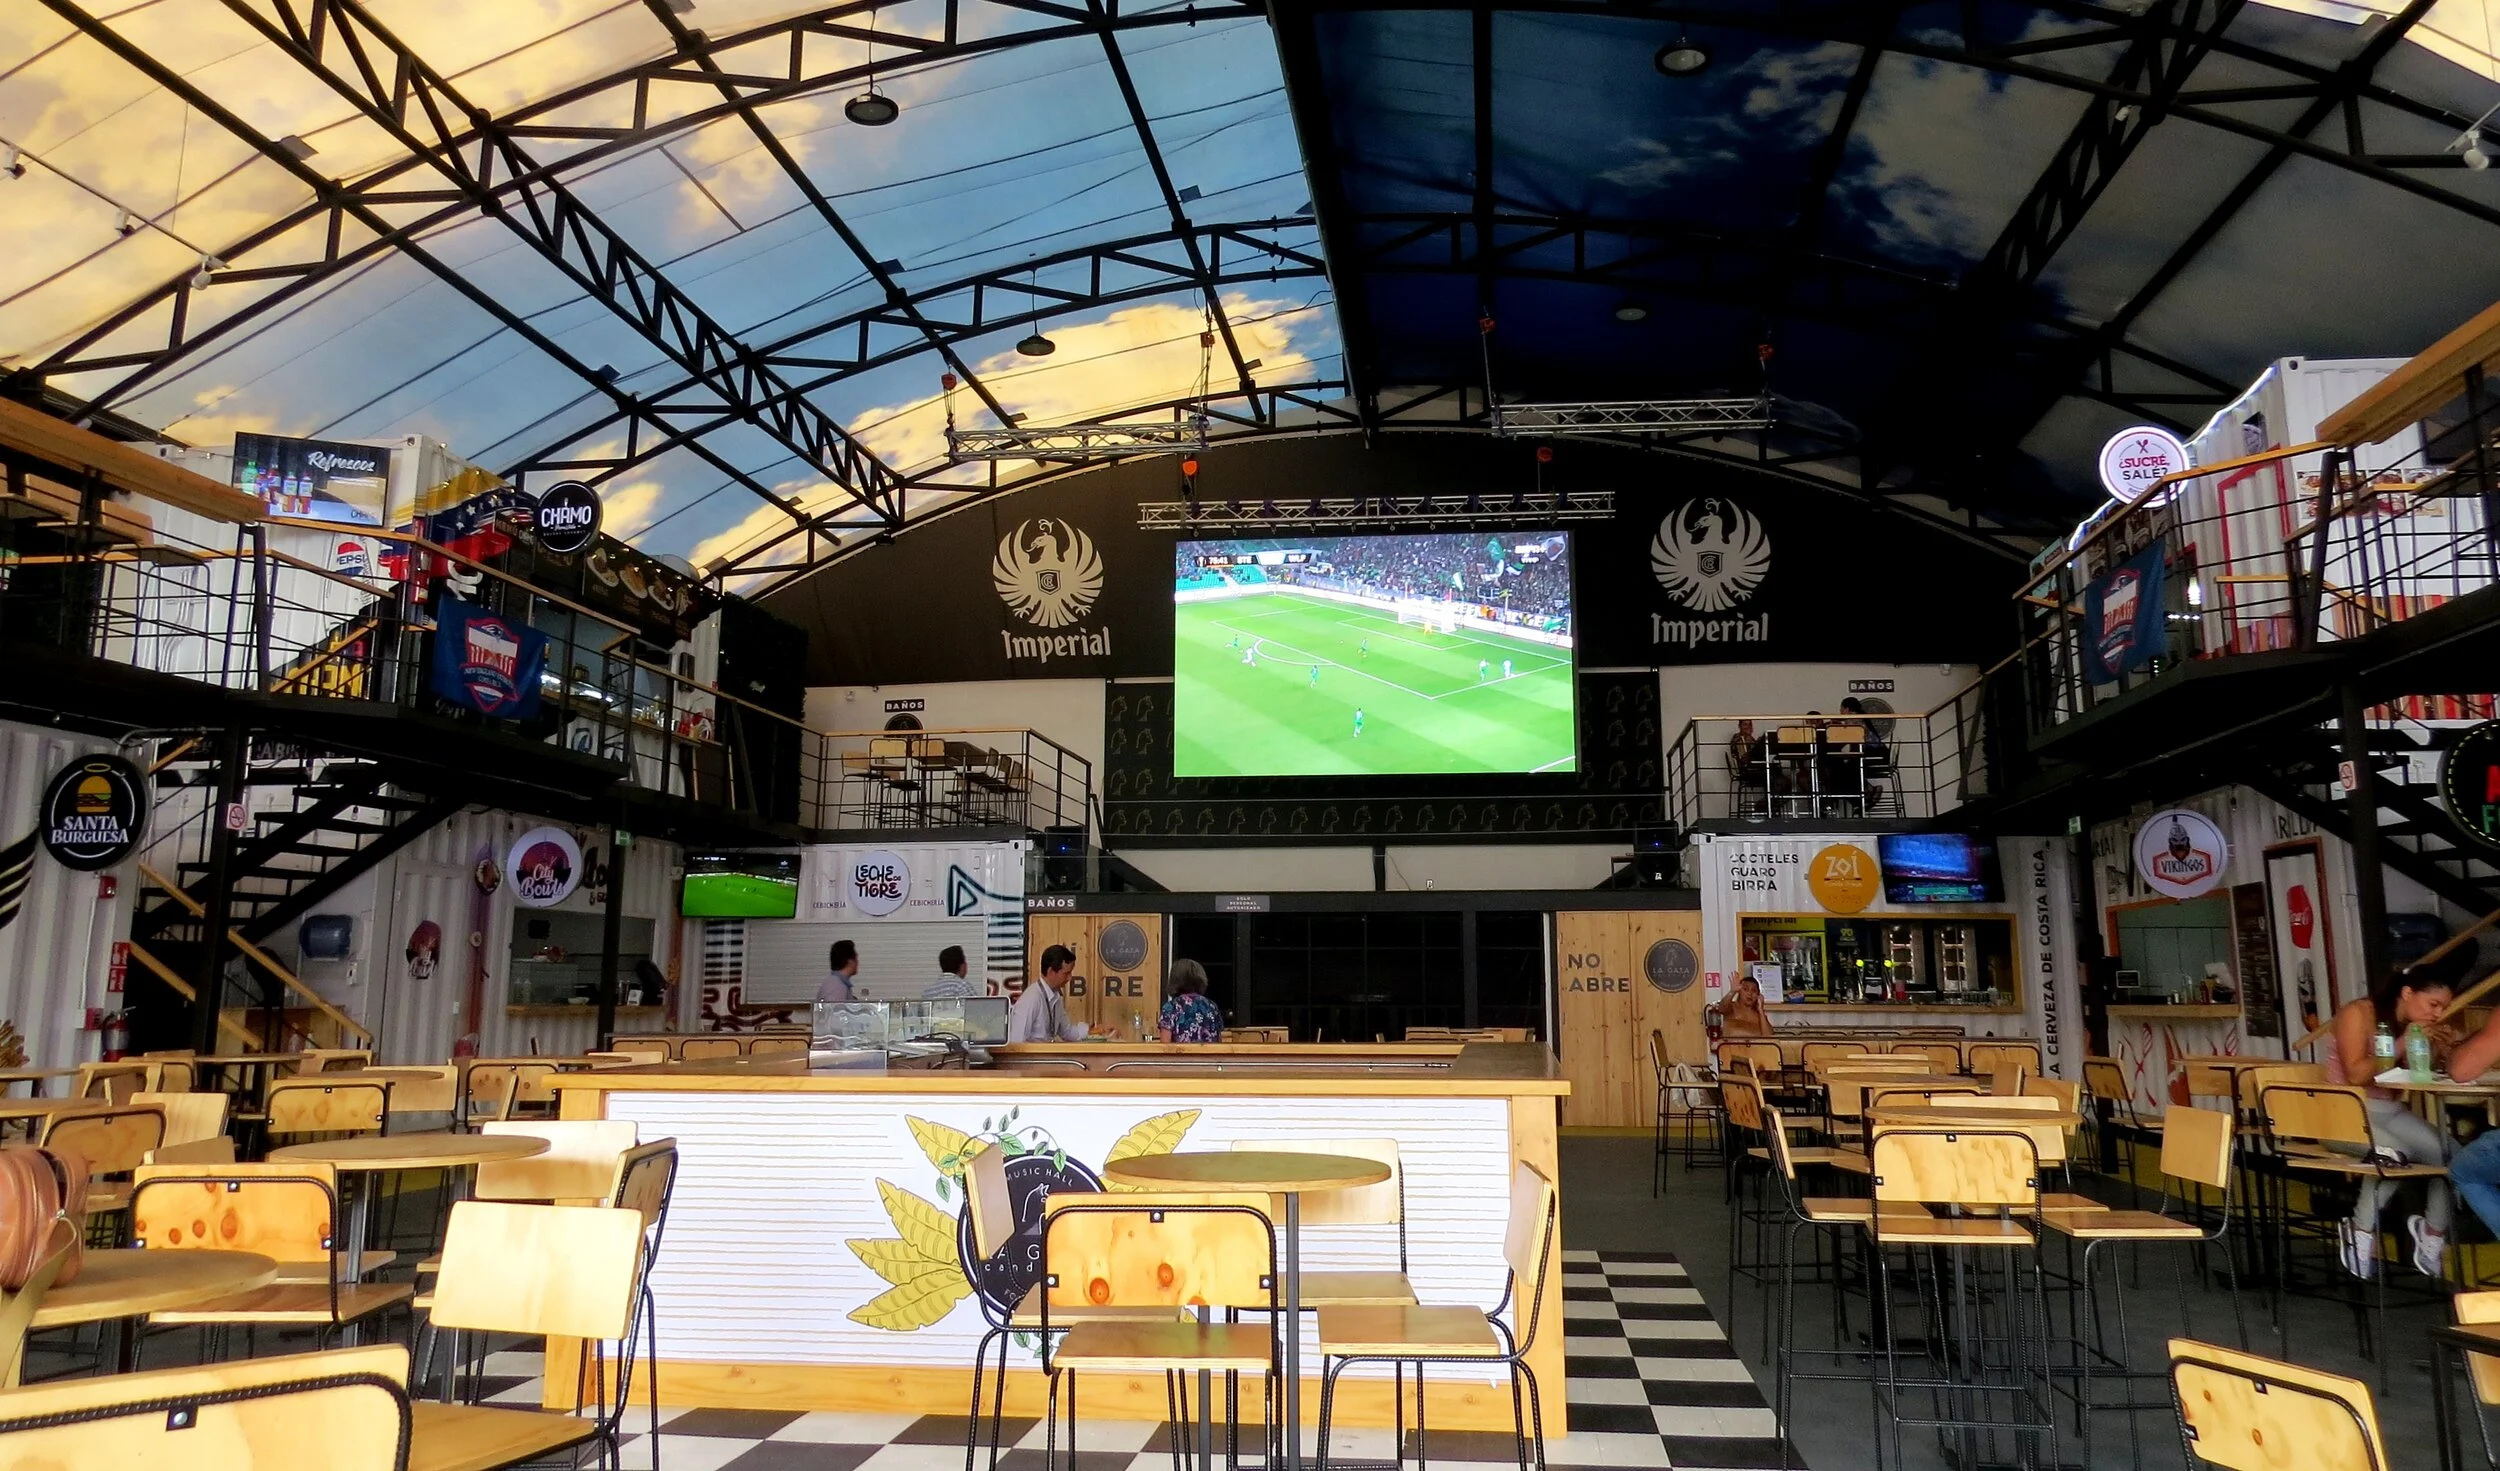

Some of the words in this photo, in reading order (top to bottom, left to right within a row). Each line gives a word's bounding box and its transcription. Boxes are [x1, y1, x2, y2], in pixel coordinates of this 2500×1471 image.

[541, 506, 592, 528] CHAMO
[1650, 612, 1769, 649] Imperial
[1001, 626, 1111, 664] Imperial
[1850, 681, 1893, 690] BAÑOS
[886, 701, 923, 710] BAÑOS
[63, 815, 119, 831] SANTA
[51, 828, 129, 844] BURGUESA
[1730, 853, 1799, 864] COCTELES
[2161, 858, 2205, 873] VIKINGOS
[533, 863, 554, 884] City
[855, 864, 894, 882] LECHE
[1731, 867, 1776, 878] GUARO
[2034, 850, 2049, 888] RICA
[520, 876, 565, 899] Bowls
[855, 882, 902, 899] TIGRE
[1732, 880, 1778, 891] BIRRA
[1028, 896, 1075, 908] BAÑOS
[2037, 895, 2051, 946] COSTA
[1568, 953, 1601, 969] NO
[2041, 952, 2052, 976] DE
[1066, 976, 1144, 997] BRE
[1569, 977, 1630, 992] ABRE
[2042, 980, 2059, 1055] CERVEZA
[1045, 1168, 1073, 1187] HALL
